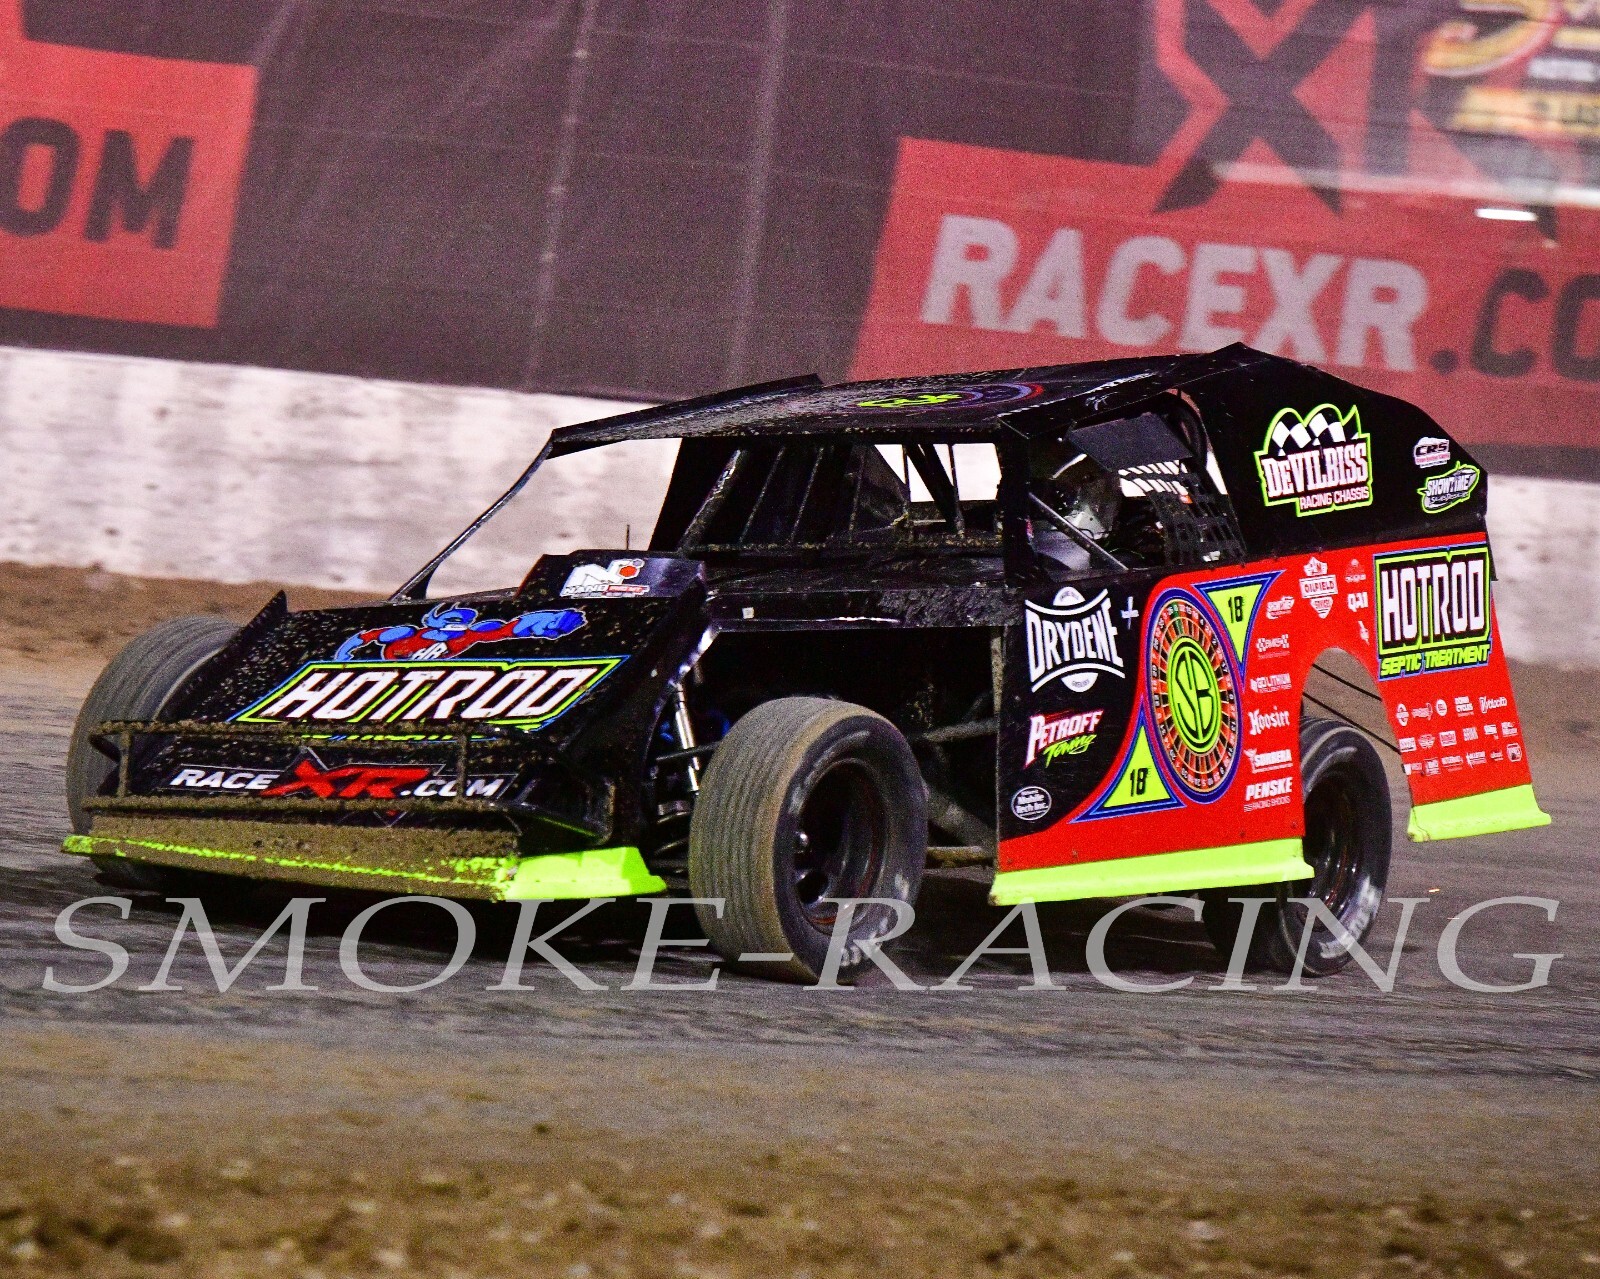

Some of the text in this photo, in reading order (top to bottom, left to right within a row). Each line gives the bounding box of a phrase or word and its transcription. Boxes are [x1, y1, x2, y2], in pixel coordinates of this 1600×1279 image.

[1261, 442, 1369, 498] DEVILBISS
[1300, 486, 1370, 510] RACING CHASSIS
[1228, 595, 1244, 624] 18
[1381, 559, 1486, 643] HOTROD
[1025, 597, 1124, 683] DRYDENE
[1380, 643, 1490, 677] SEPTIC TREATMENT
[257, 667, 600, 720] HOTROD
[1024, 709, 1104, 769] PETROFF
[1130, 767, 1149, 797] 18
[1245, 777, 1293, 801] PENSKE
